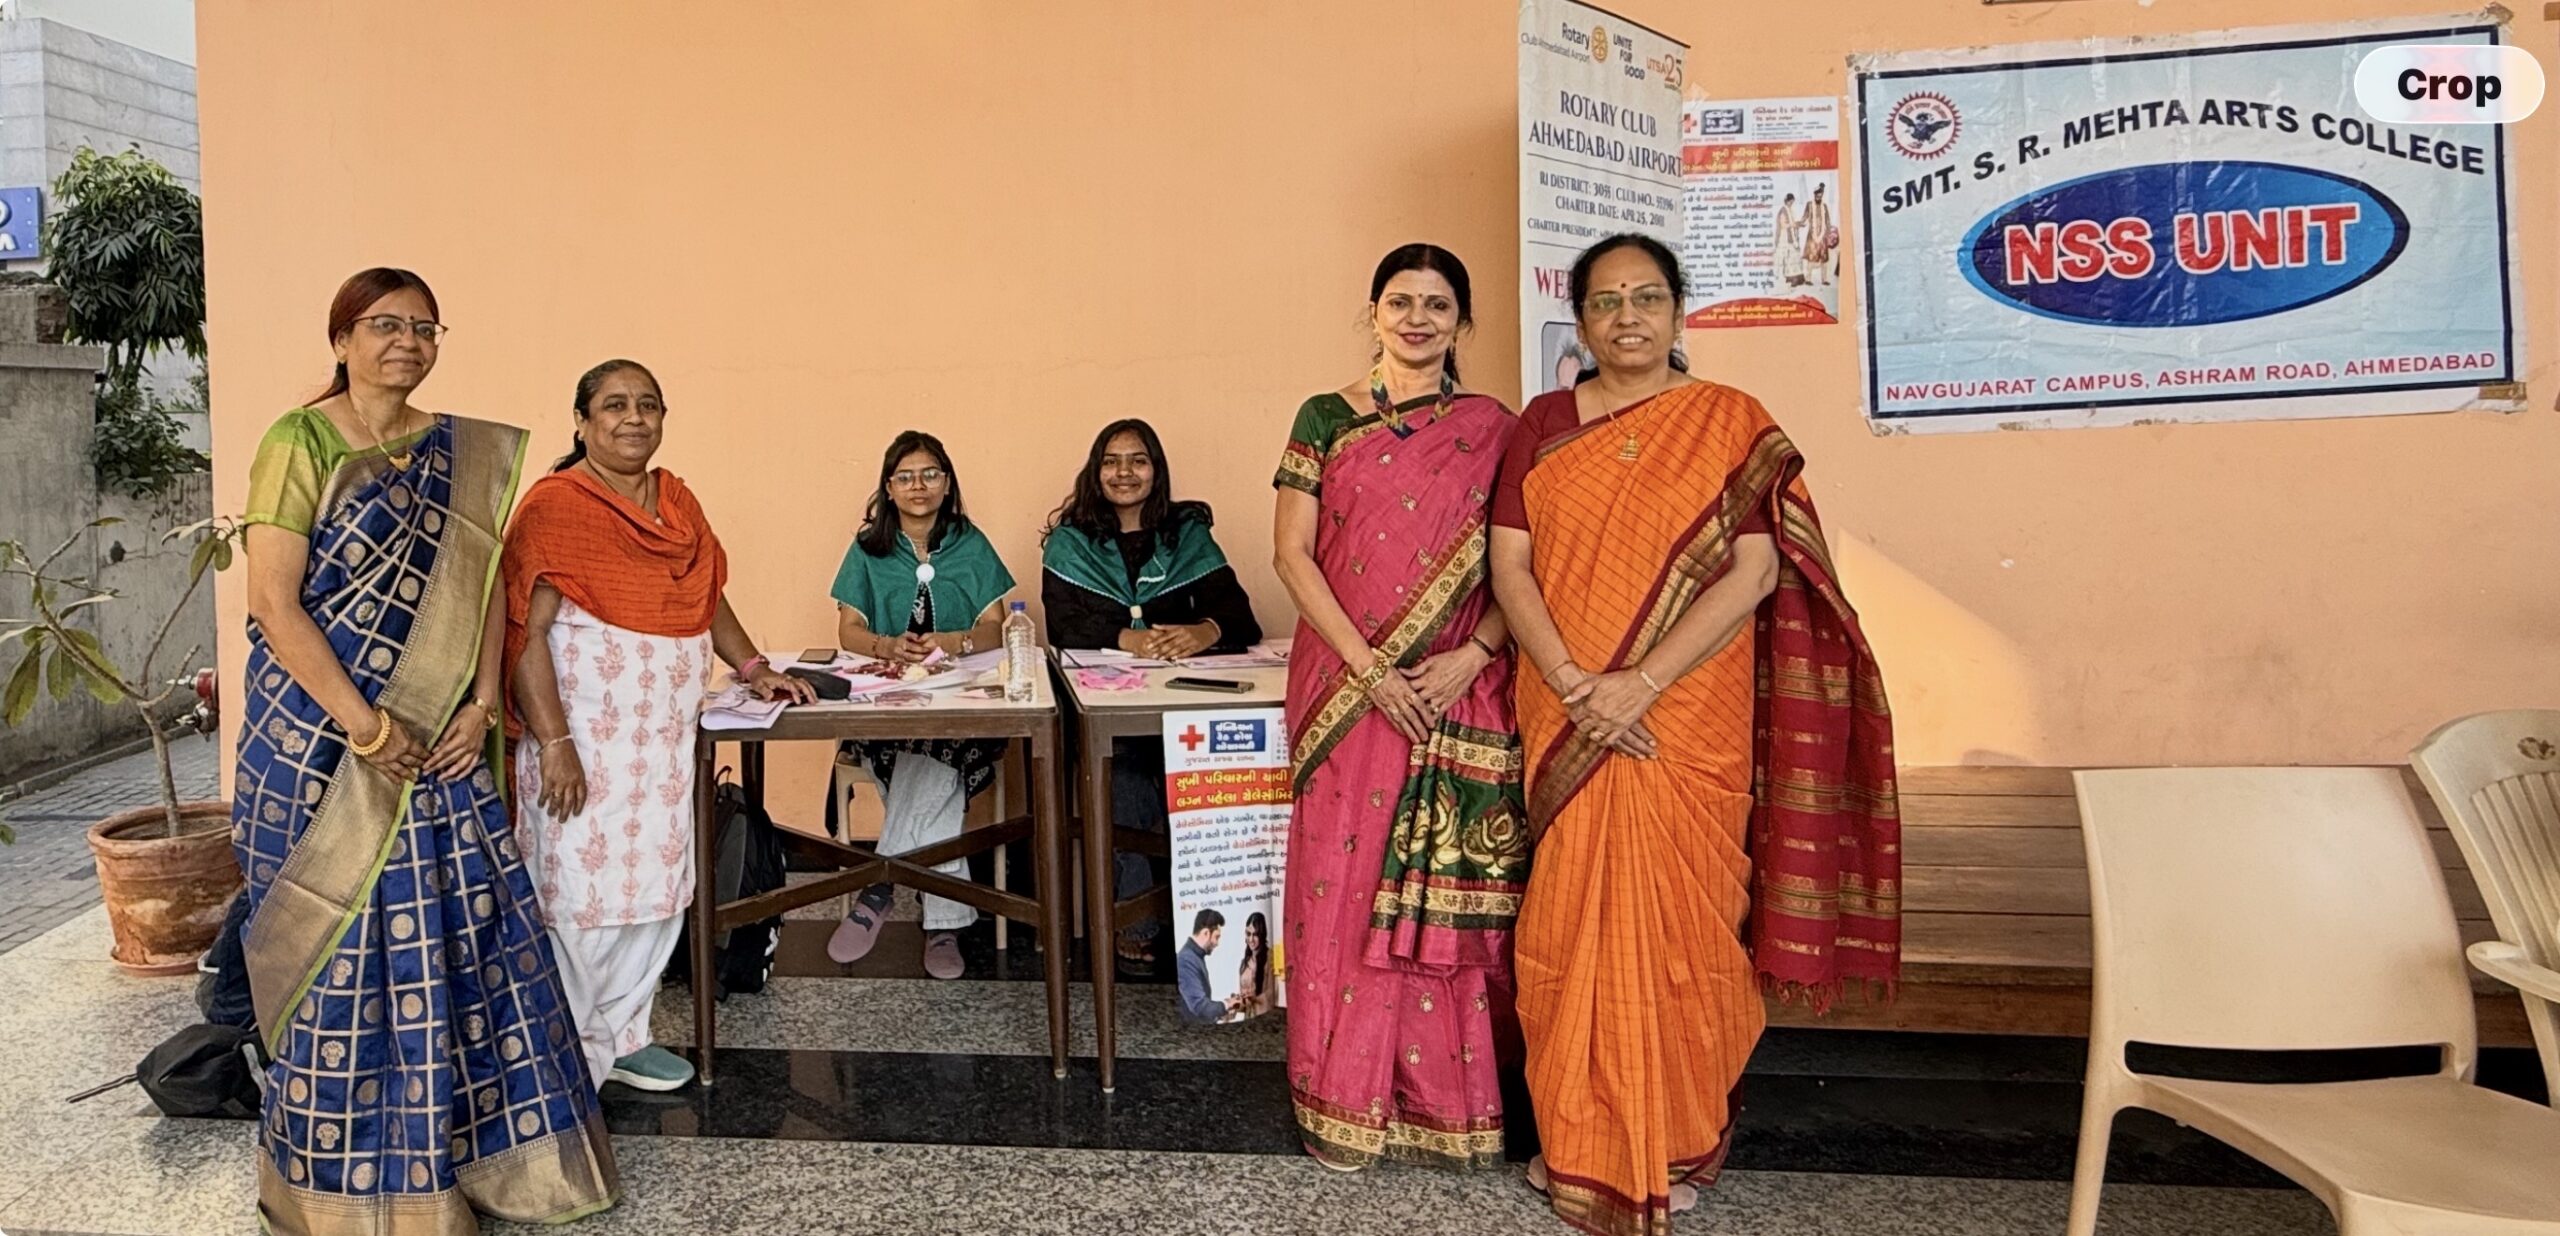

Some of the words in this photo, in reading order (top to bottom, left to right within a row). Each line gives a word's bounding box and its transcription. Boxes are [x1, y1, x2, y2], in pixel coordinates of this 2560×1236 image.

[1562, 22, 1590, 51] Rotary
[1613, 34, 1633, 51] UNITE
[1619, 50, 1633, 63] FOR
[1624, 65, 1646, 80] GOOD
[1560, 90, 1618, 127] ROTARY
[1621, 109, 1657, 137] CLUB
[1529, 120, 1625, 162] AHMEDABAD
[1628, 146, 1683, 178] AIRPORT
[1882, 164, 1961, 214] SMT.
[1973, 151, 2005, 180] S.
[2018, 134, 2050, 165] R.
[2063, 99, 2190, 149] MEHTA
[2198, 99, 2299, 134] ARTS
[2312, 112, 2485, 175] COLLEGE
[1555, 195, 1596, 215] CHARTER
[1527, 217, 1560, 233] CHARTER
[2004, 217, 2155, 285] NSS
[2173, 203, 2360, 274] UNIT
[1886, 379, 2036, 401] NAVGUJARAT
[2046, 372, 2150, 393] CAMPUS,
[2157, 366, 2256, 387] ASHRAM
[2266, 362, 2337, 380] ROAD,
[2344, 352, 2495, 376] AHMEDABAD
